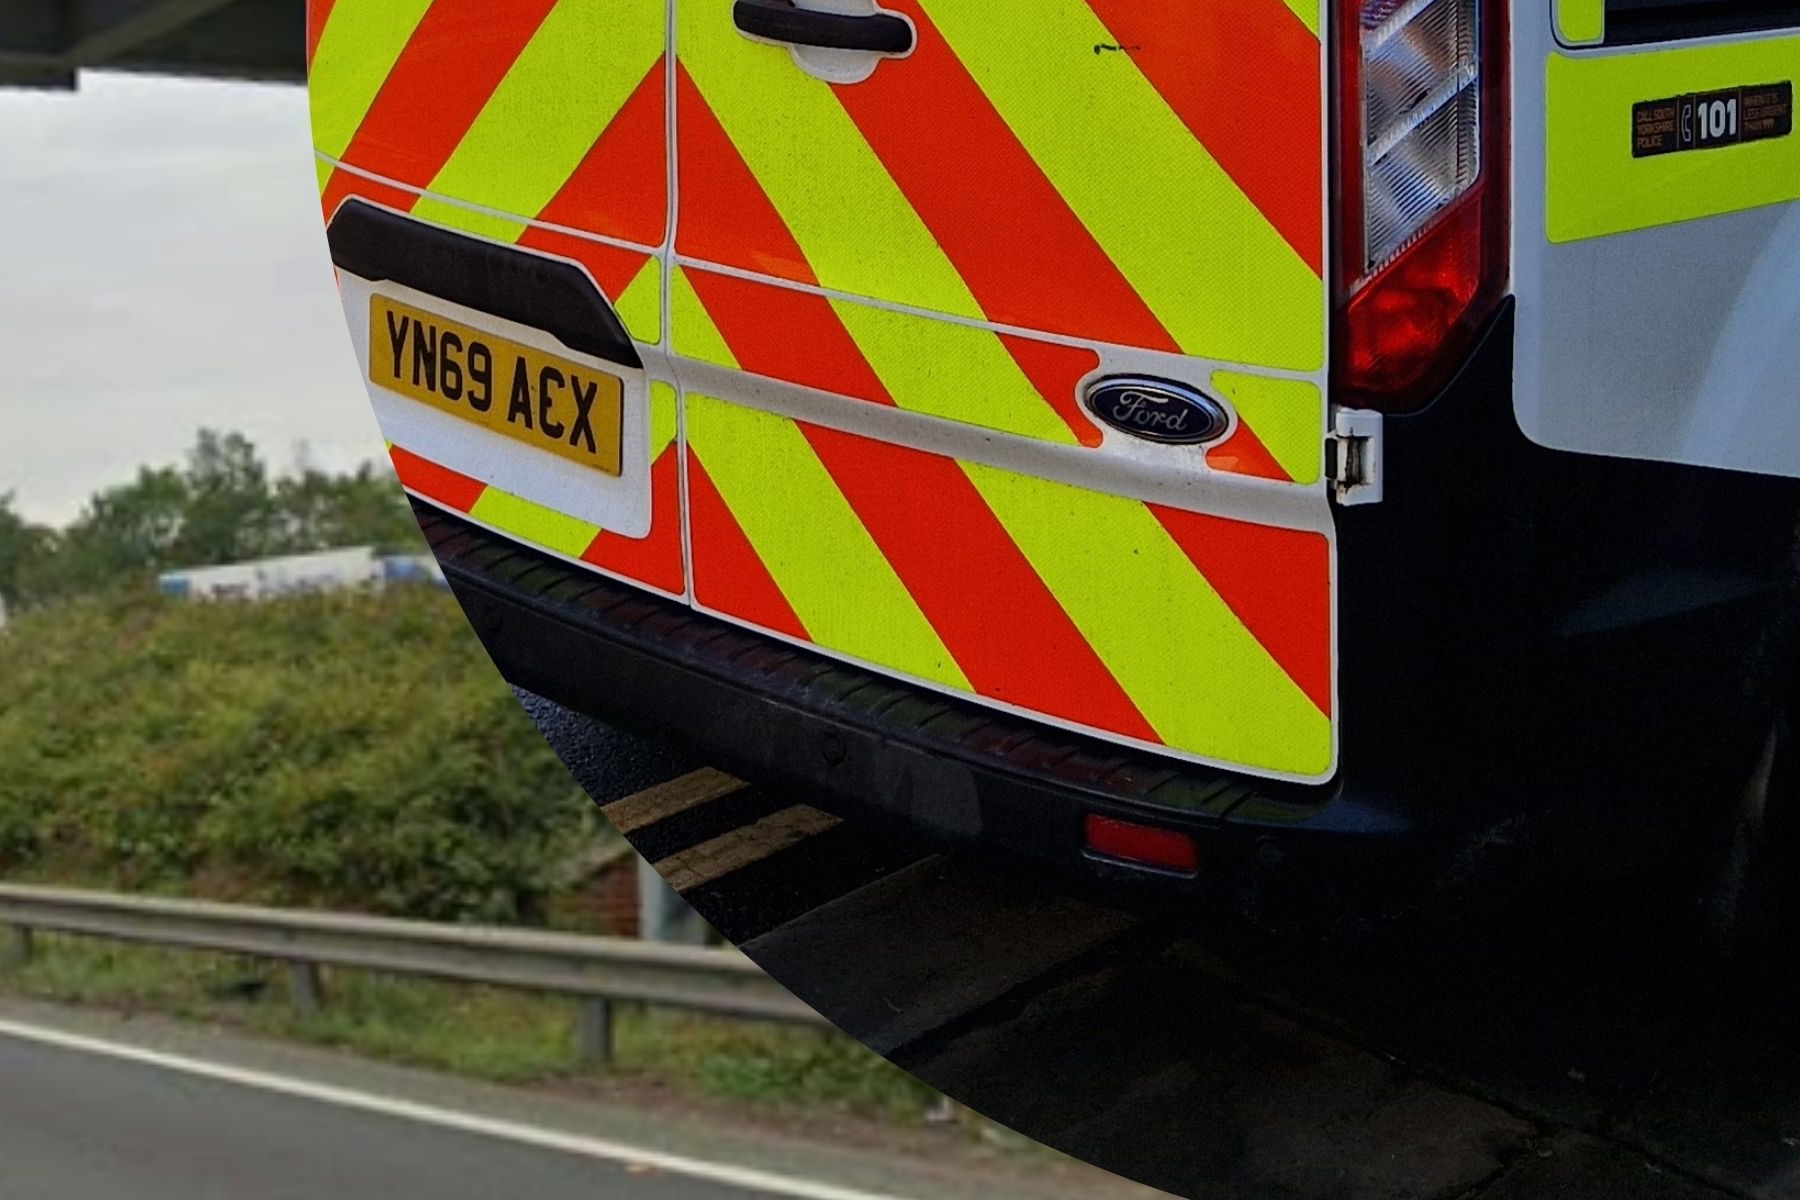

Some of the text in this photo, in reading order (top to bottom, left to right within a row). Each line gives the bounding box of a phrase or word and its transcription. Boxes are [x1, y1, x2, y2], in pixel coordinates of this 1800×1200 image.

[1697, 98, 1737, 140] 101
[386, 310, 493, 413] YN69
[1112, 390, 1188, 431] Ford
